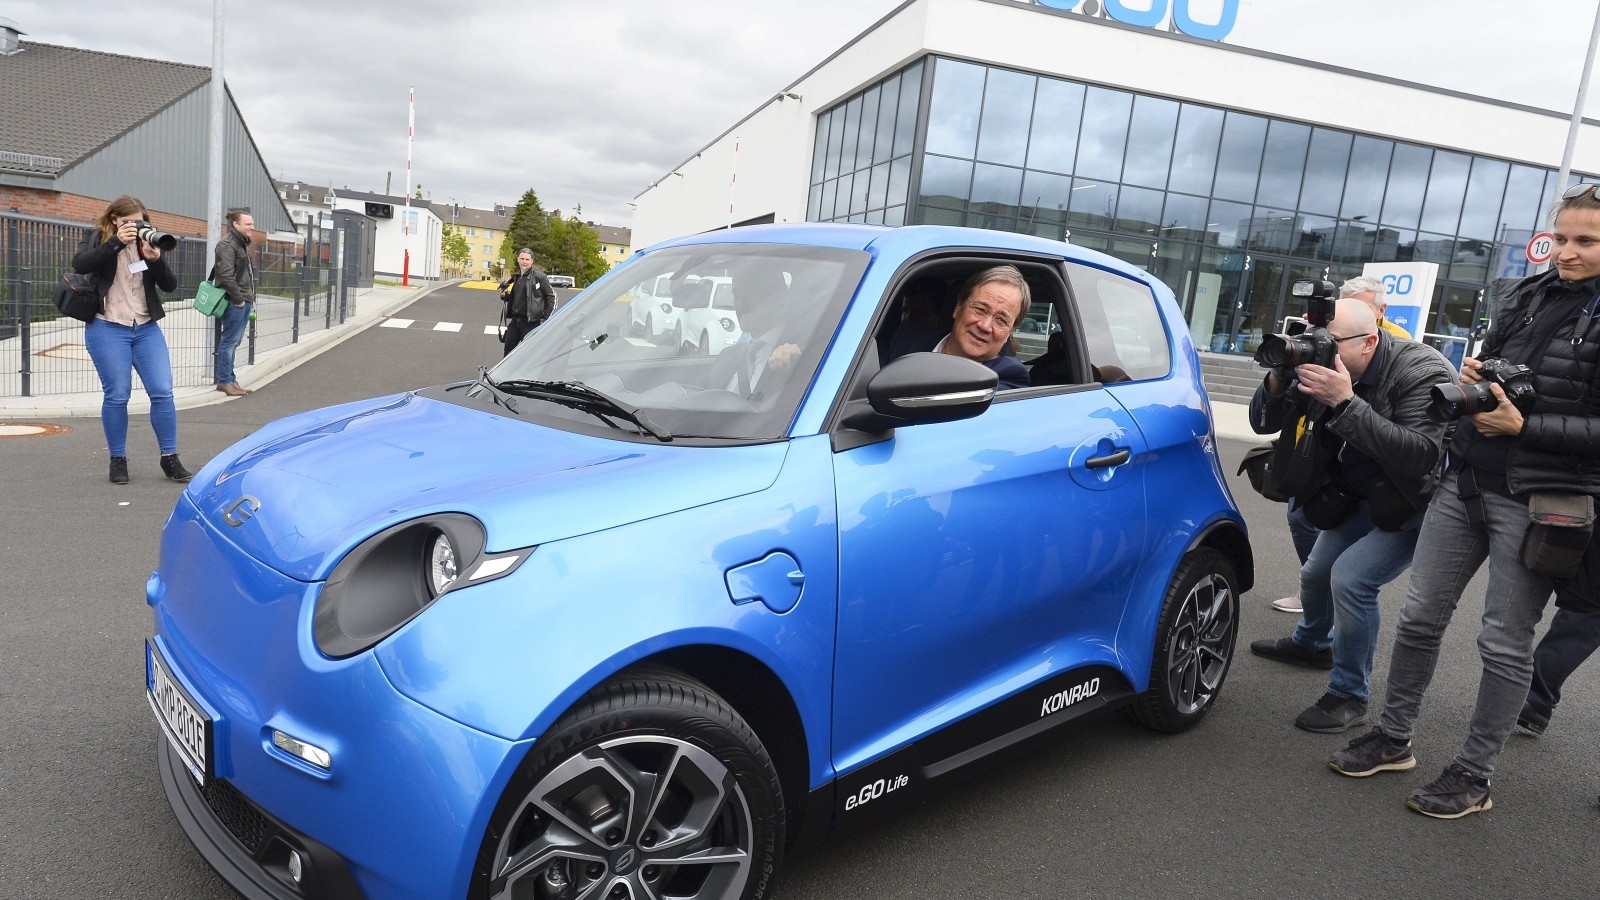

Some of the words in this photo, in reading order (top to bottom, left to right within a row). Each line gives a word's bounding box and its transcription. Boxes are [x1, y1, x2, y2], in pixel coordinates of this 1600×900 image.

[1535, 241, 1550, 255] 10
[1040, 677, 1100, 717] KONRAD
[845, 778, 885, 811] e.GO
[886, 774, 909, 793] Life
